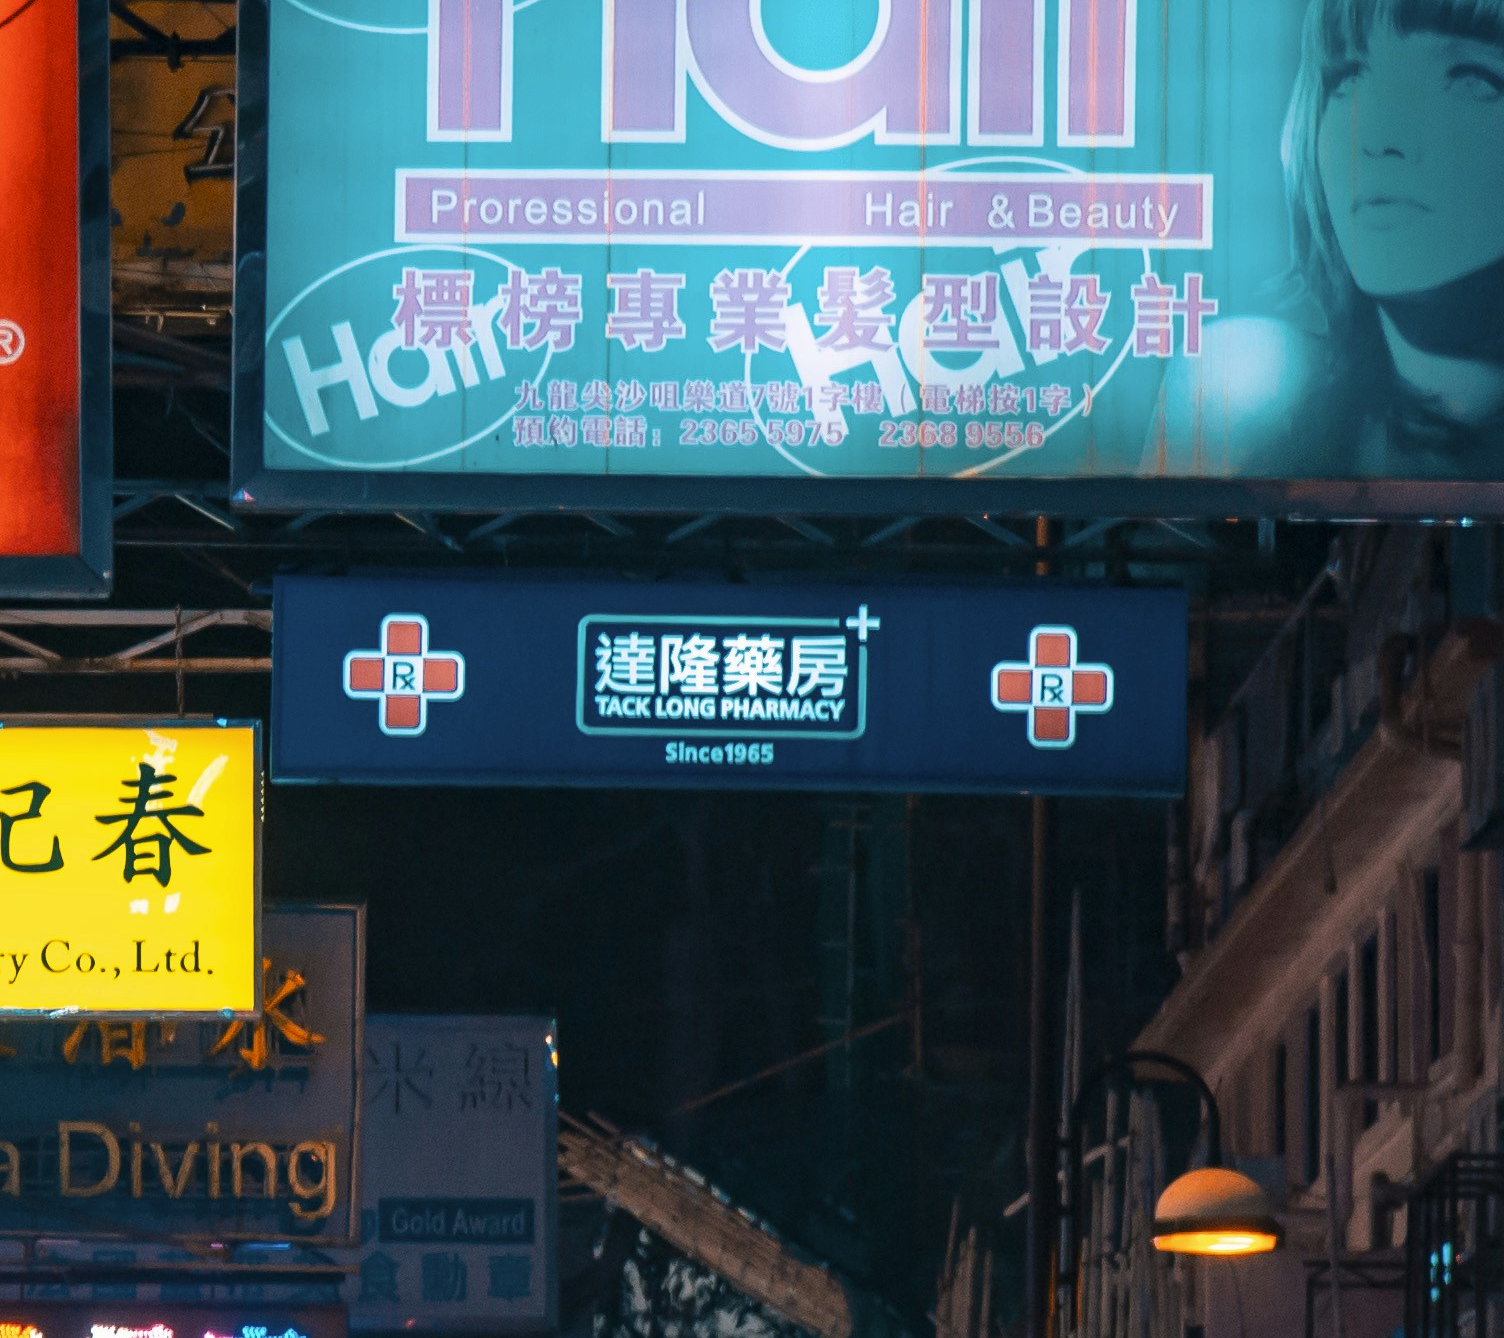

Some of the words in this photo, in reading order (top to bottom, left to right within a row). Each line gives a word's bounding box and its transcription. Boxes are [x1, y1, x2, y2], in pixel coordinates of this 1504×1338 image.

[865, 190, 955, 227] Hair
[986, 193, 1016, 229] &
[1027, 191, 1179, 237] Beauty
[392, 263, 1219, 359] 標榜專業髮型設計
[678, 417, 758, 448] 2365
[765, 417, 846, 449] 5975
[878, 418, 958, 449] 2368
[965, 419, 1046, 449] 9556
[595, 632, 849, 697] 達隆藥房
[595, 696, 652, 720] TACK
[656, 697, 716, 721] LONG
[721, 697, 845, 722] PHARMACY
[134, 940, 214, 975] Ltd.
[58, 1118, 338, 1218] Diving
[392, 1207, 445, 1236] Gold
[451, 1207, 526, 1237] Award
